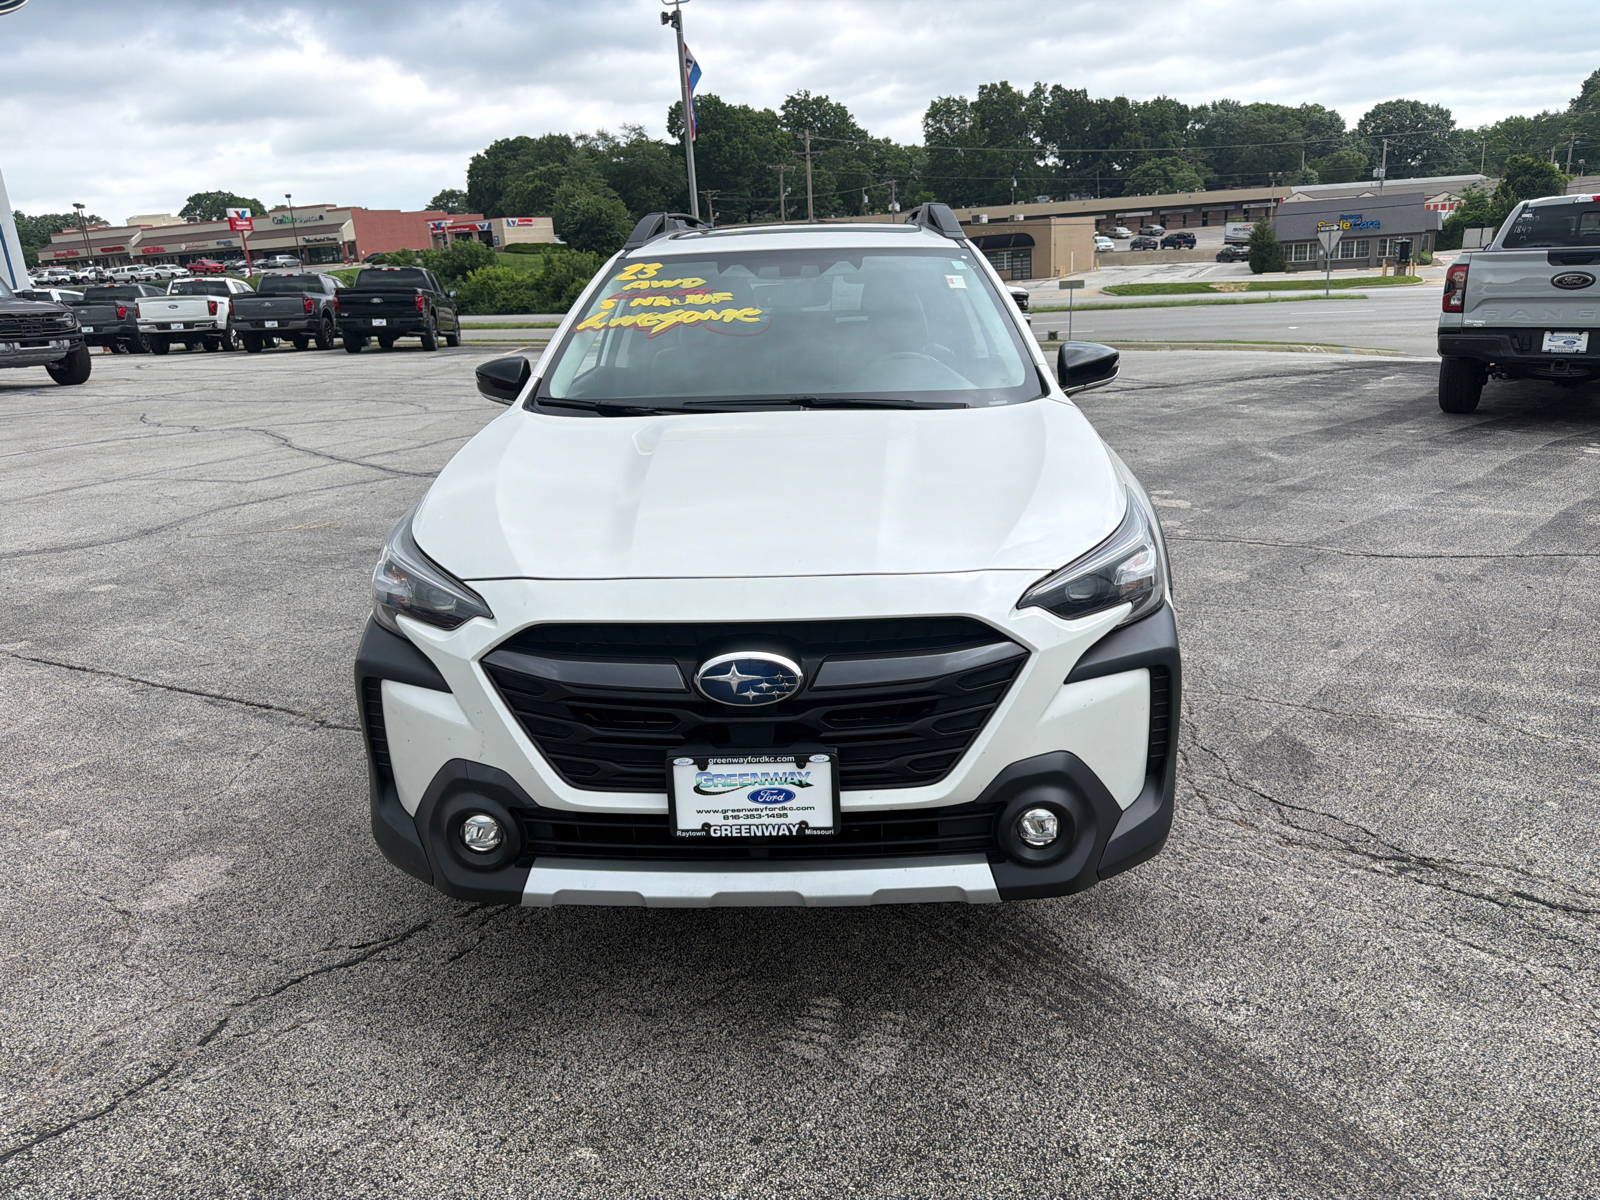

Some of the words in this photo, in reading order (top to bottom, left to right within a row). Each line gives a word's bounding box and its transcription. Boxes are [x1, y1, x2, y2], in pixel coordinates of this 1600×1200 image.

[1352, 219, 1380, 229] Care
[615, 262, 663, 281] 23
[622, 277, 707, 291] AWD
[708, 755, 795, 765] greenwayfordkc.com
[695, 771, 812, 788] GREENWAY
[757, 789, 786, 803] Ford
[696, 805, 815, 815] www.greenwayfordkc.com
[710, 824, 800, 837] GREENWAY
